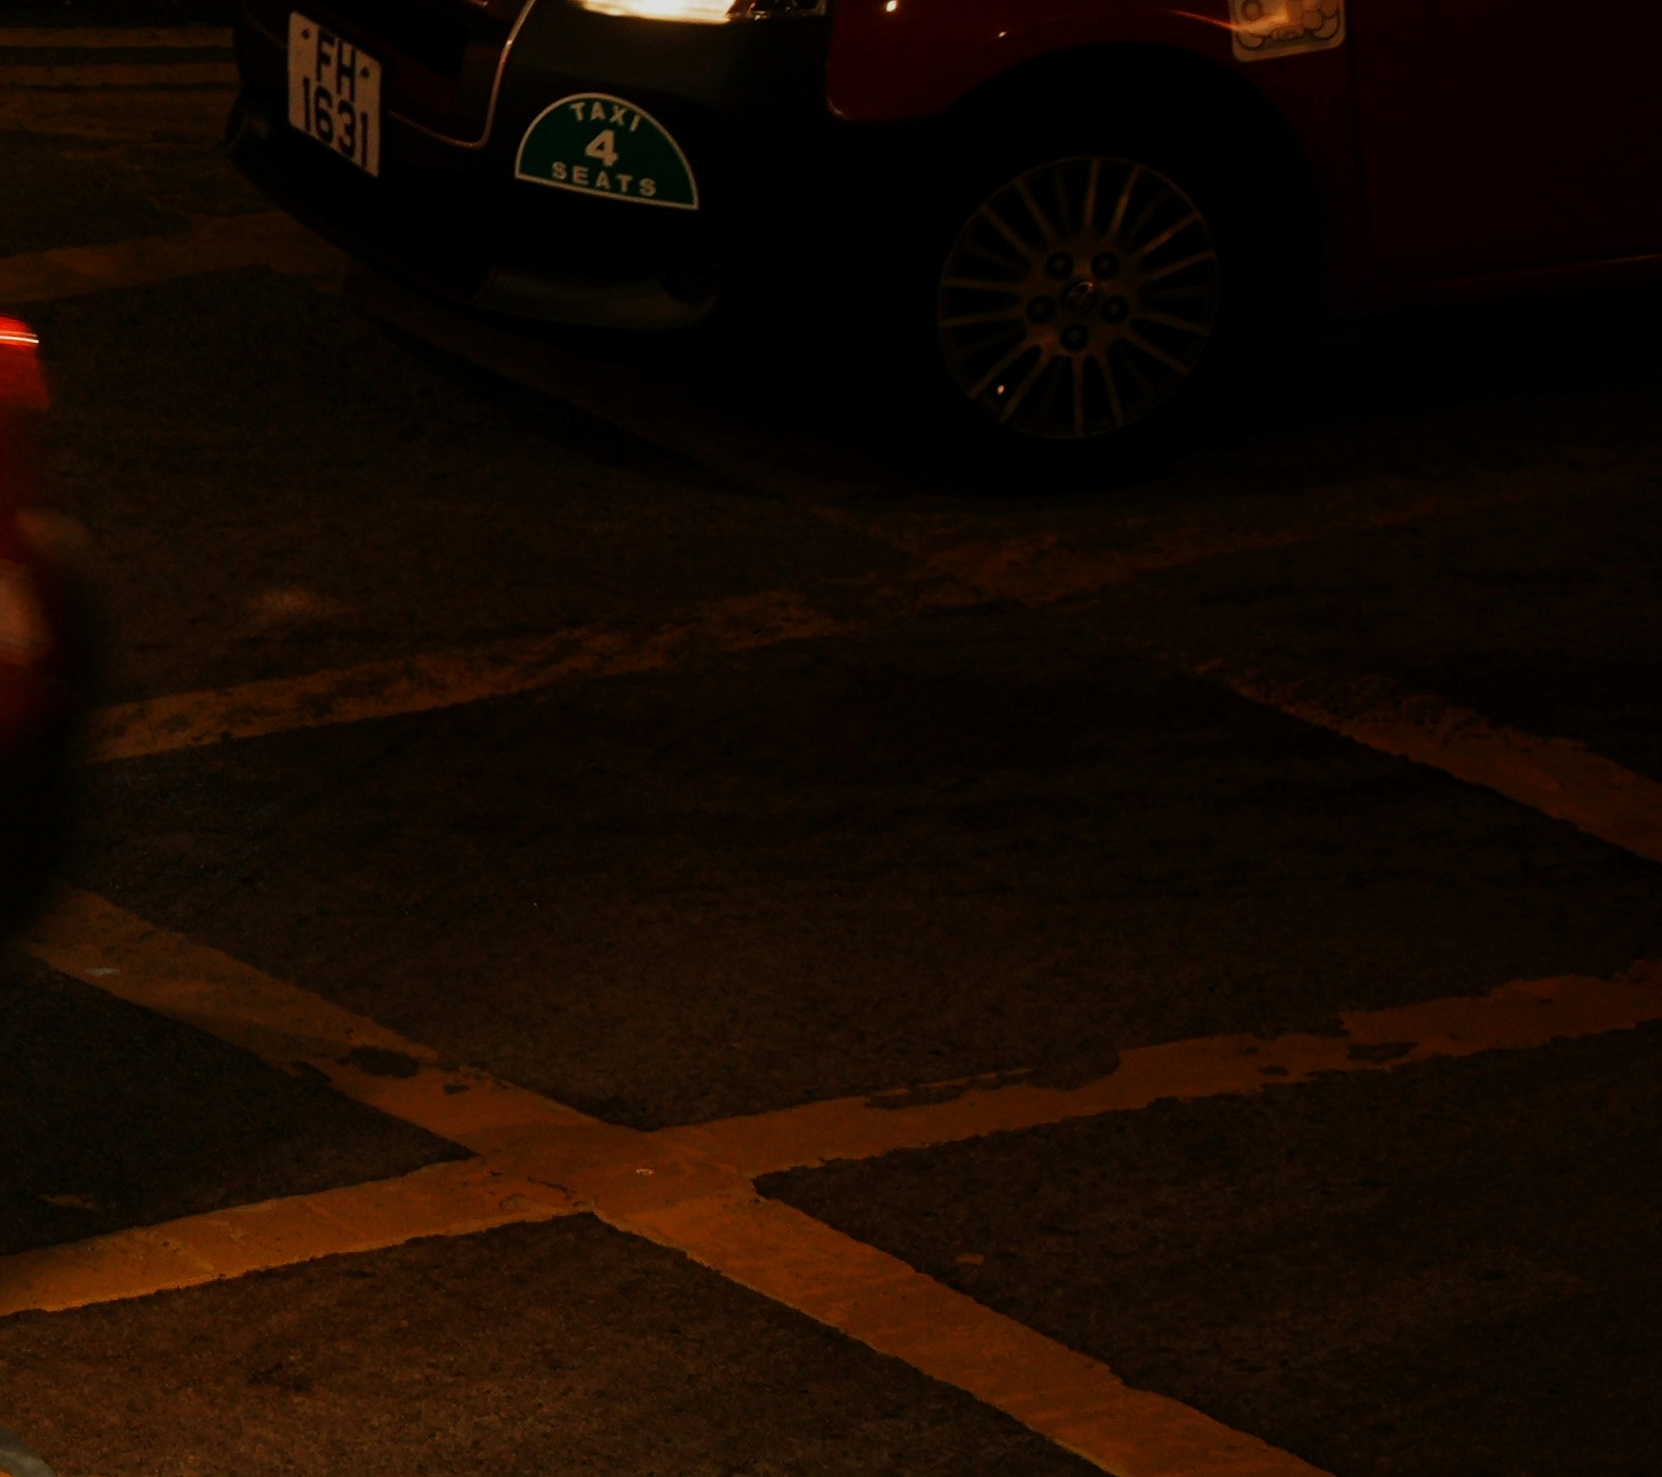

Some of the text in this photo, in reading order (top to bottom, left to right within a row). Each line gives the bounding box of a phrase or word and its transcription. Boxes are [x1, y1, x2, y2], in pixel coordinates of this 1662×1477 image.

[316, 27, 357, 103] FH
[302, 75, 369, 169] 1631
[567, 100, 644, 135] TAXI
[584, 129, 620, 168] 4
[550, 160, 658, 198] SEATS
